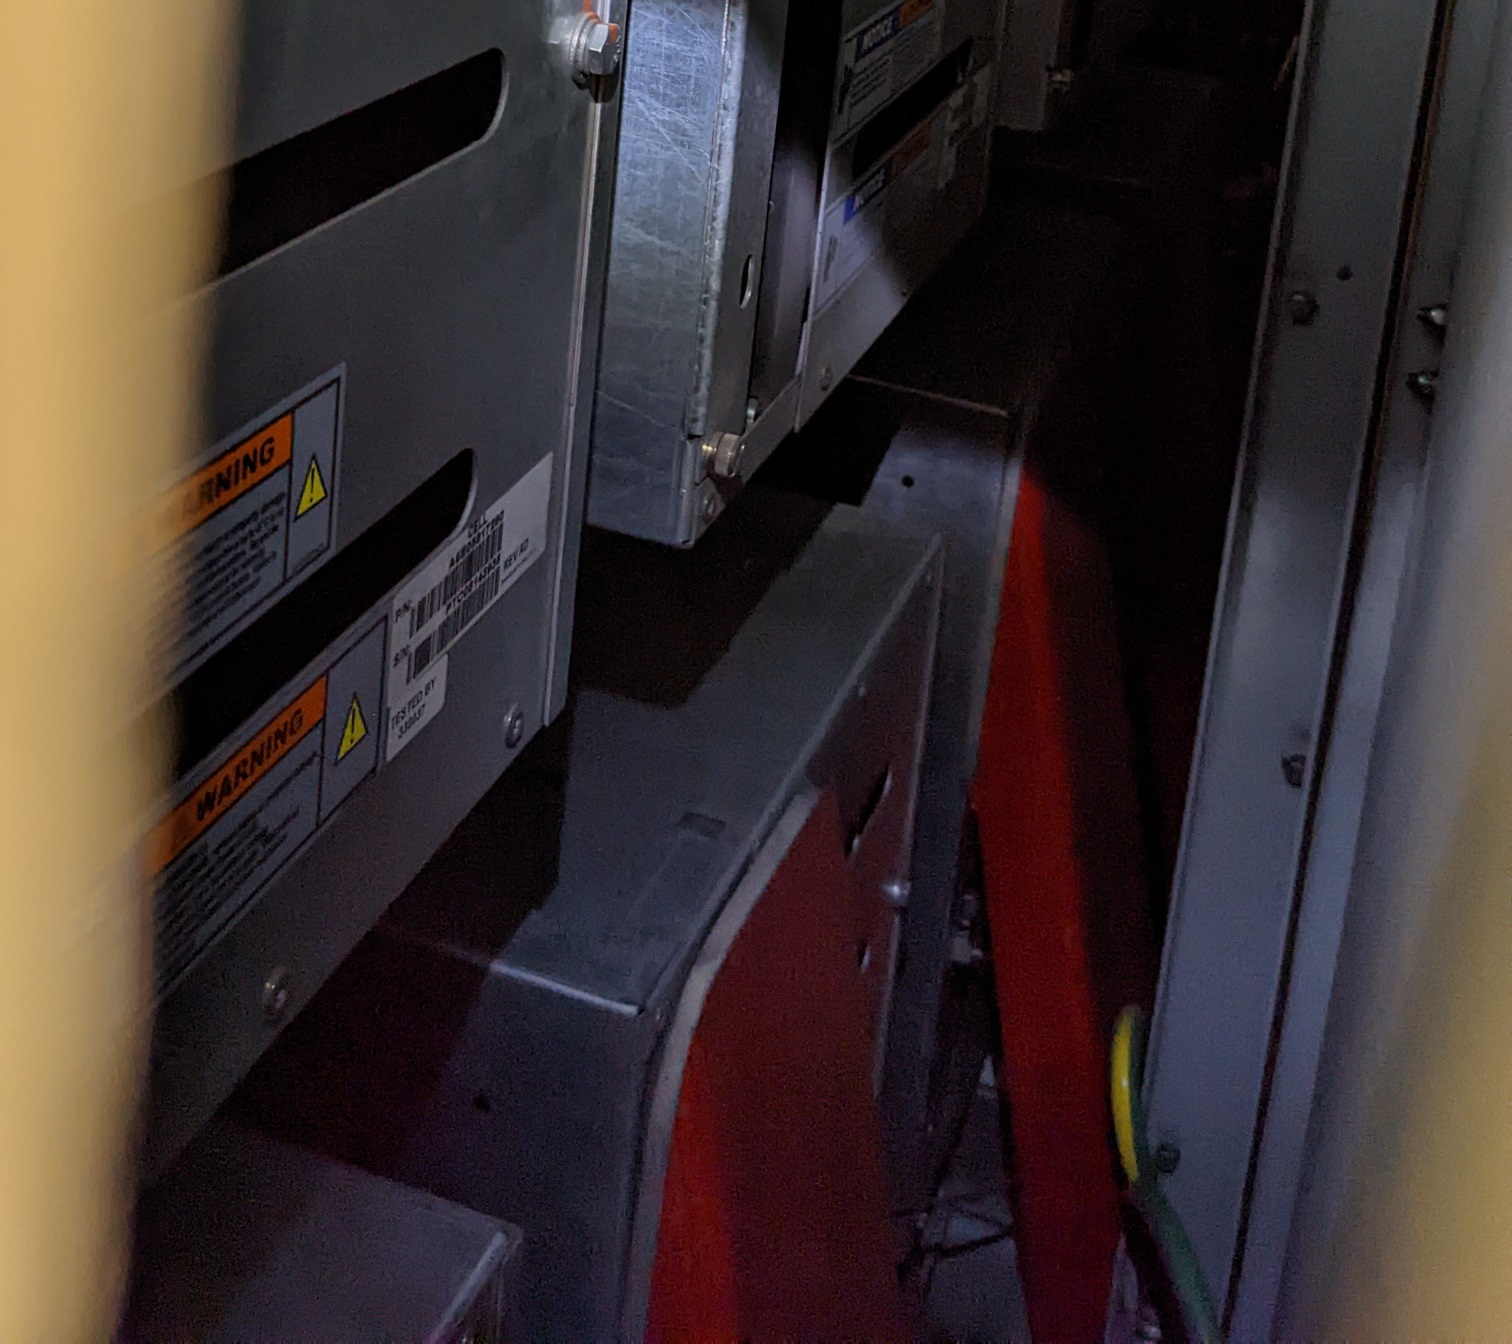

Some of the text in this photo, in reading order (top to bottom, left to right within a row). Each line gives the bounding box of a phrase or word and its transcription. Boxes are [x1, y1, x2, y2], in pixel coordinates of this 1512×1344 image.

[192, 437, 275, 507] RNING
[467, 515, 488, 539] CELL
[504, 550, 518, 571] REV
[391, 676, 436, 730] TESTED BY
[196, 709, 304, 821] WARNING
